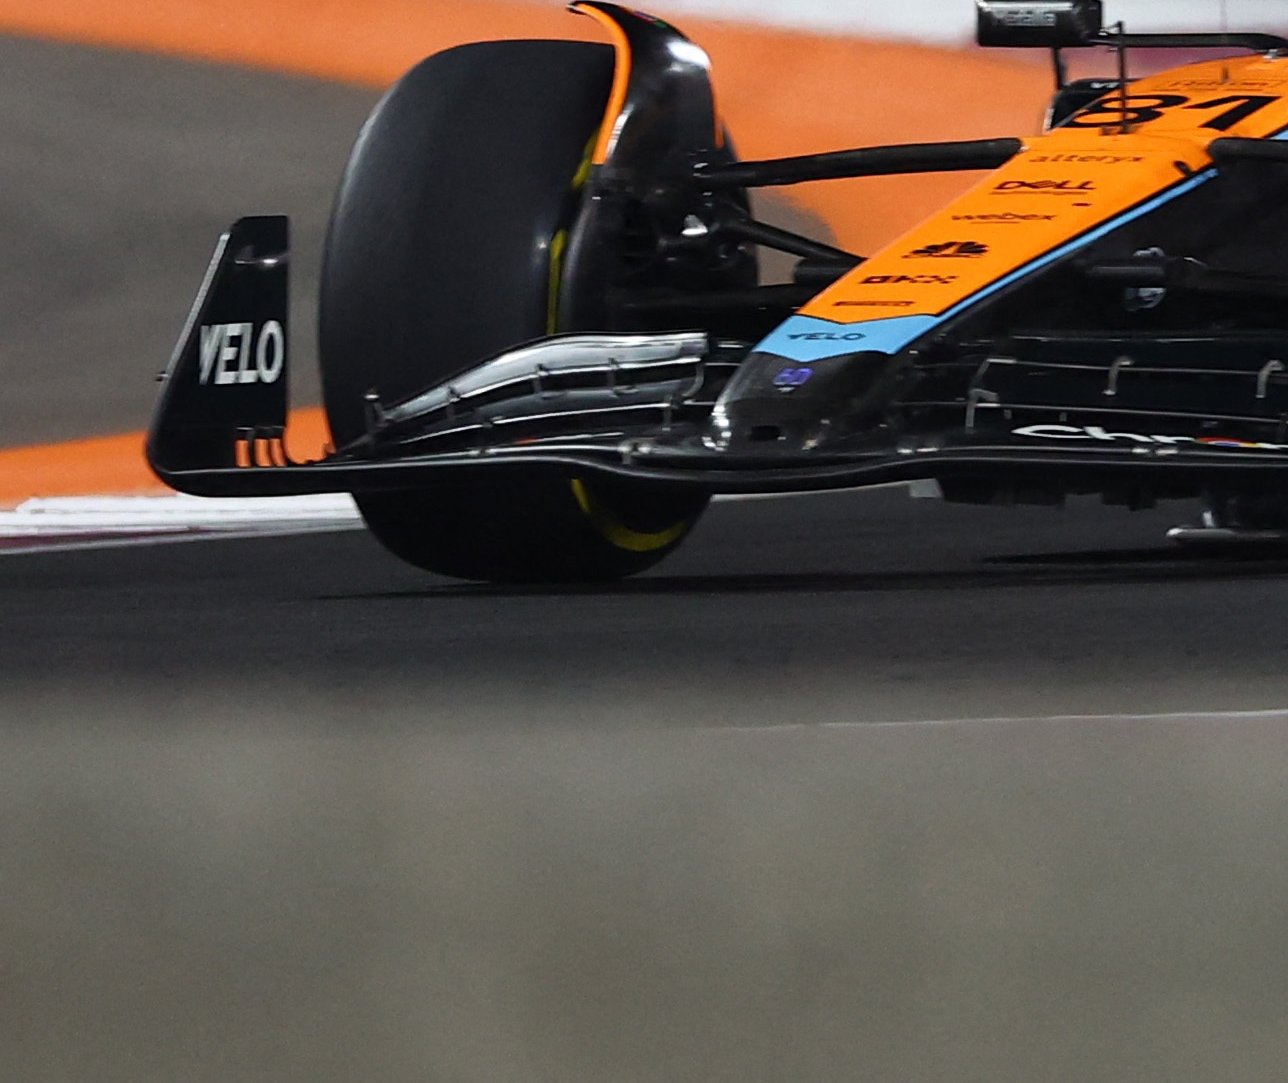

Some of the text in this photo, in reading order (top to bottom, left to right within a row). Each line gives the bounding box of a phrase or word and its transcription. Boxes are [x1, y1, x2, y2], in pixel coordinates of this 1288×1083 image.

[1064, 95, 1283, 131] 81
[1029, 154, 1145, 164] alteryx
[993, 180, 1097, 190] DELL
[787, 332, 867, 341] VELO
[199, 320, 284, 385] VELO
